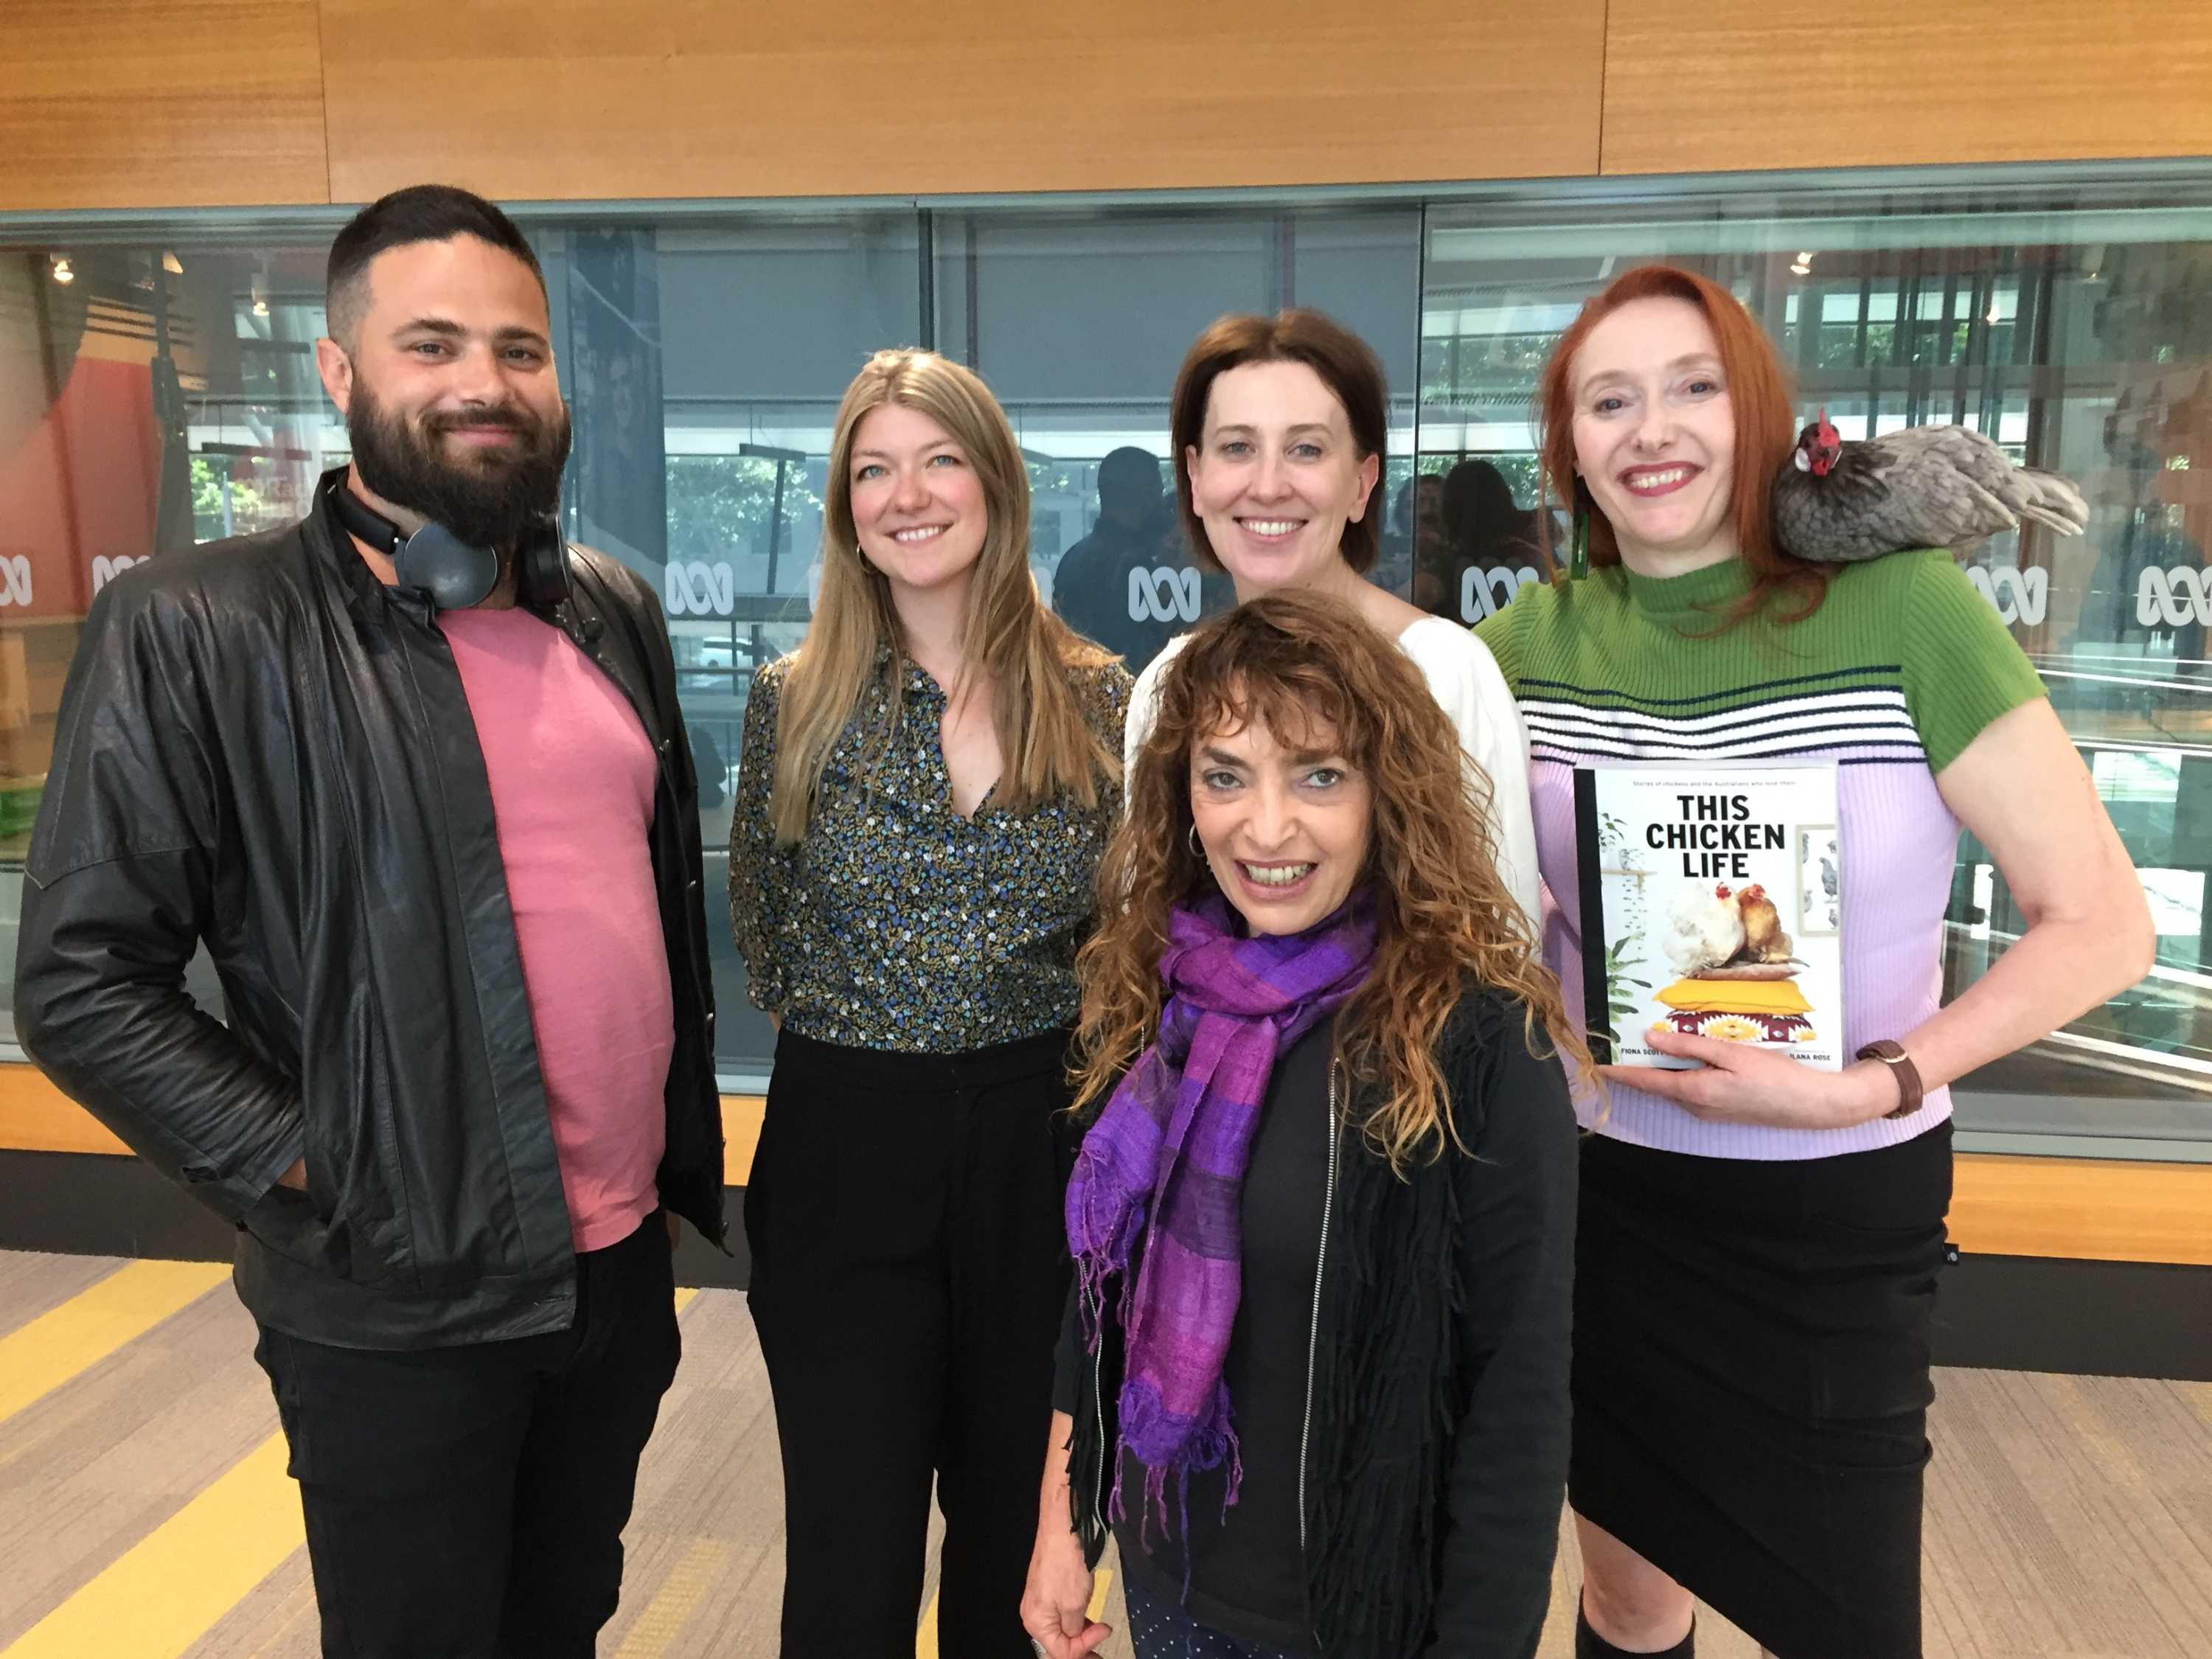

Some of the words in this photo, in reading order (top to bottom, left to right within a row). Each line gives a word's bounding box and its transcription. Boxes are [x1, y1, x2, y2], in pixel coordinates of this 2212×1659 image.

[1677, 795, 1750, 821] THIS
[1646, 823, 1785, 849] CHICKEN
[1683, 852, 1750, 878] LIFE
